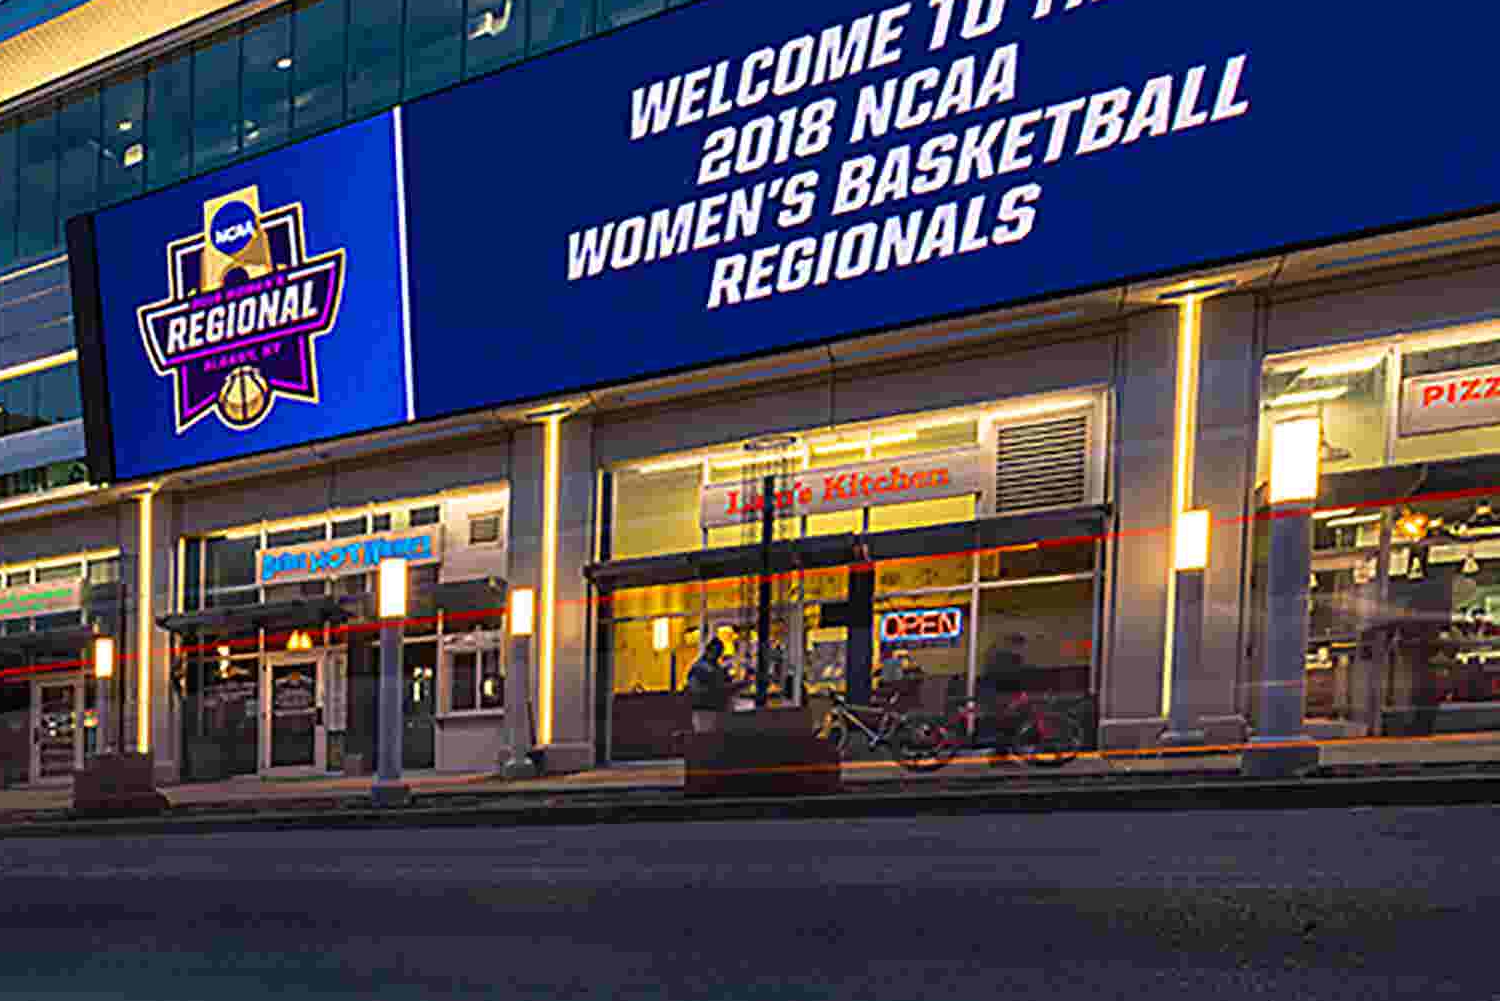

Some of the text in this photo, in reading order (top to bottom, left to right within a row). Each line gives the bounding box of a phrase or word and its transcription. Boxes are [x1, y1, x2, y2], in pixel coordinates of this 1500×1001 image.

[630, 2, 912, 140] WELCOME
[696, 42, 1019, 185] 2018 NCAA
[567, 54, 1249, 281] WOMEN'S BASKETBALL
[214, 219, 255, 244] NCAA
[706, 183, 1042, 309] REGIONALS
[166, 280, 318, 354] REGIONAL
[822, 466, 949, 502] Kitchen
[883, 612, 960, 638] OPEN
